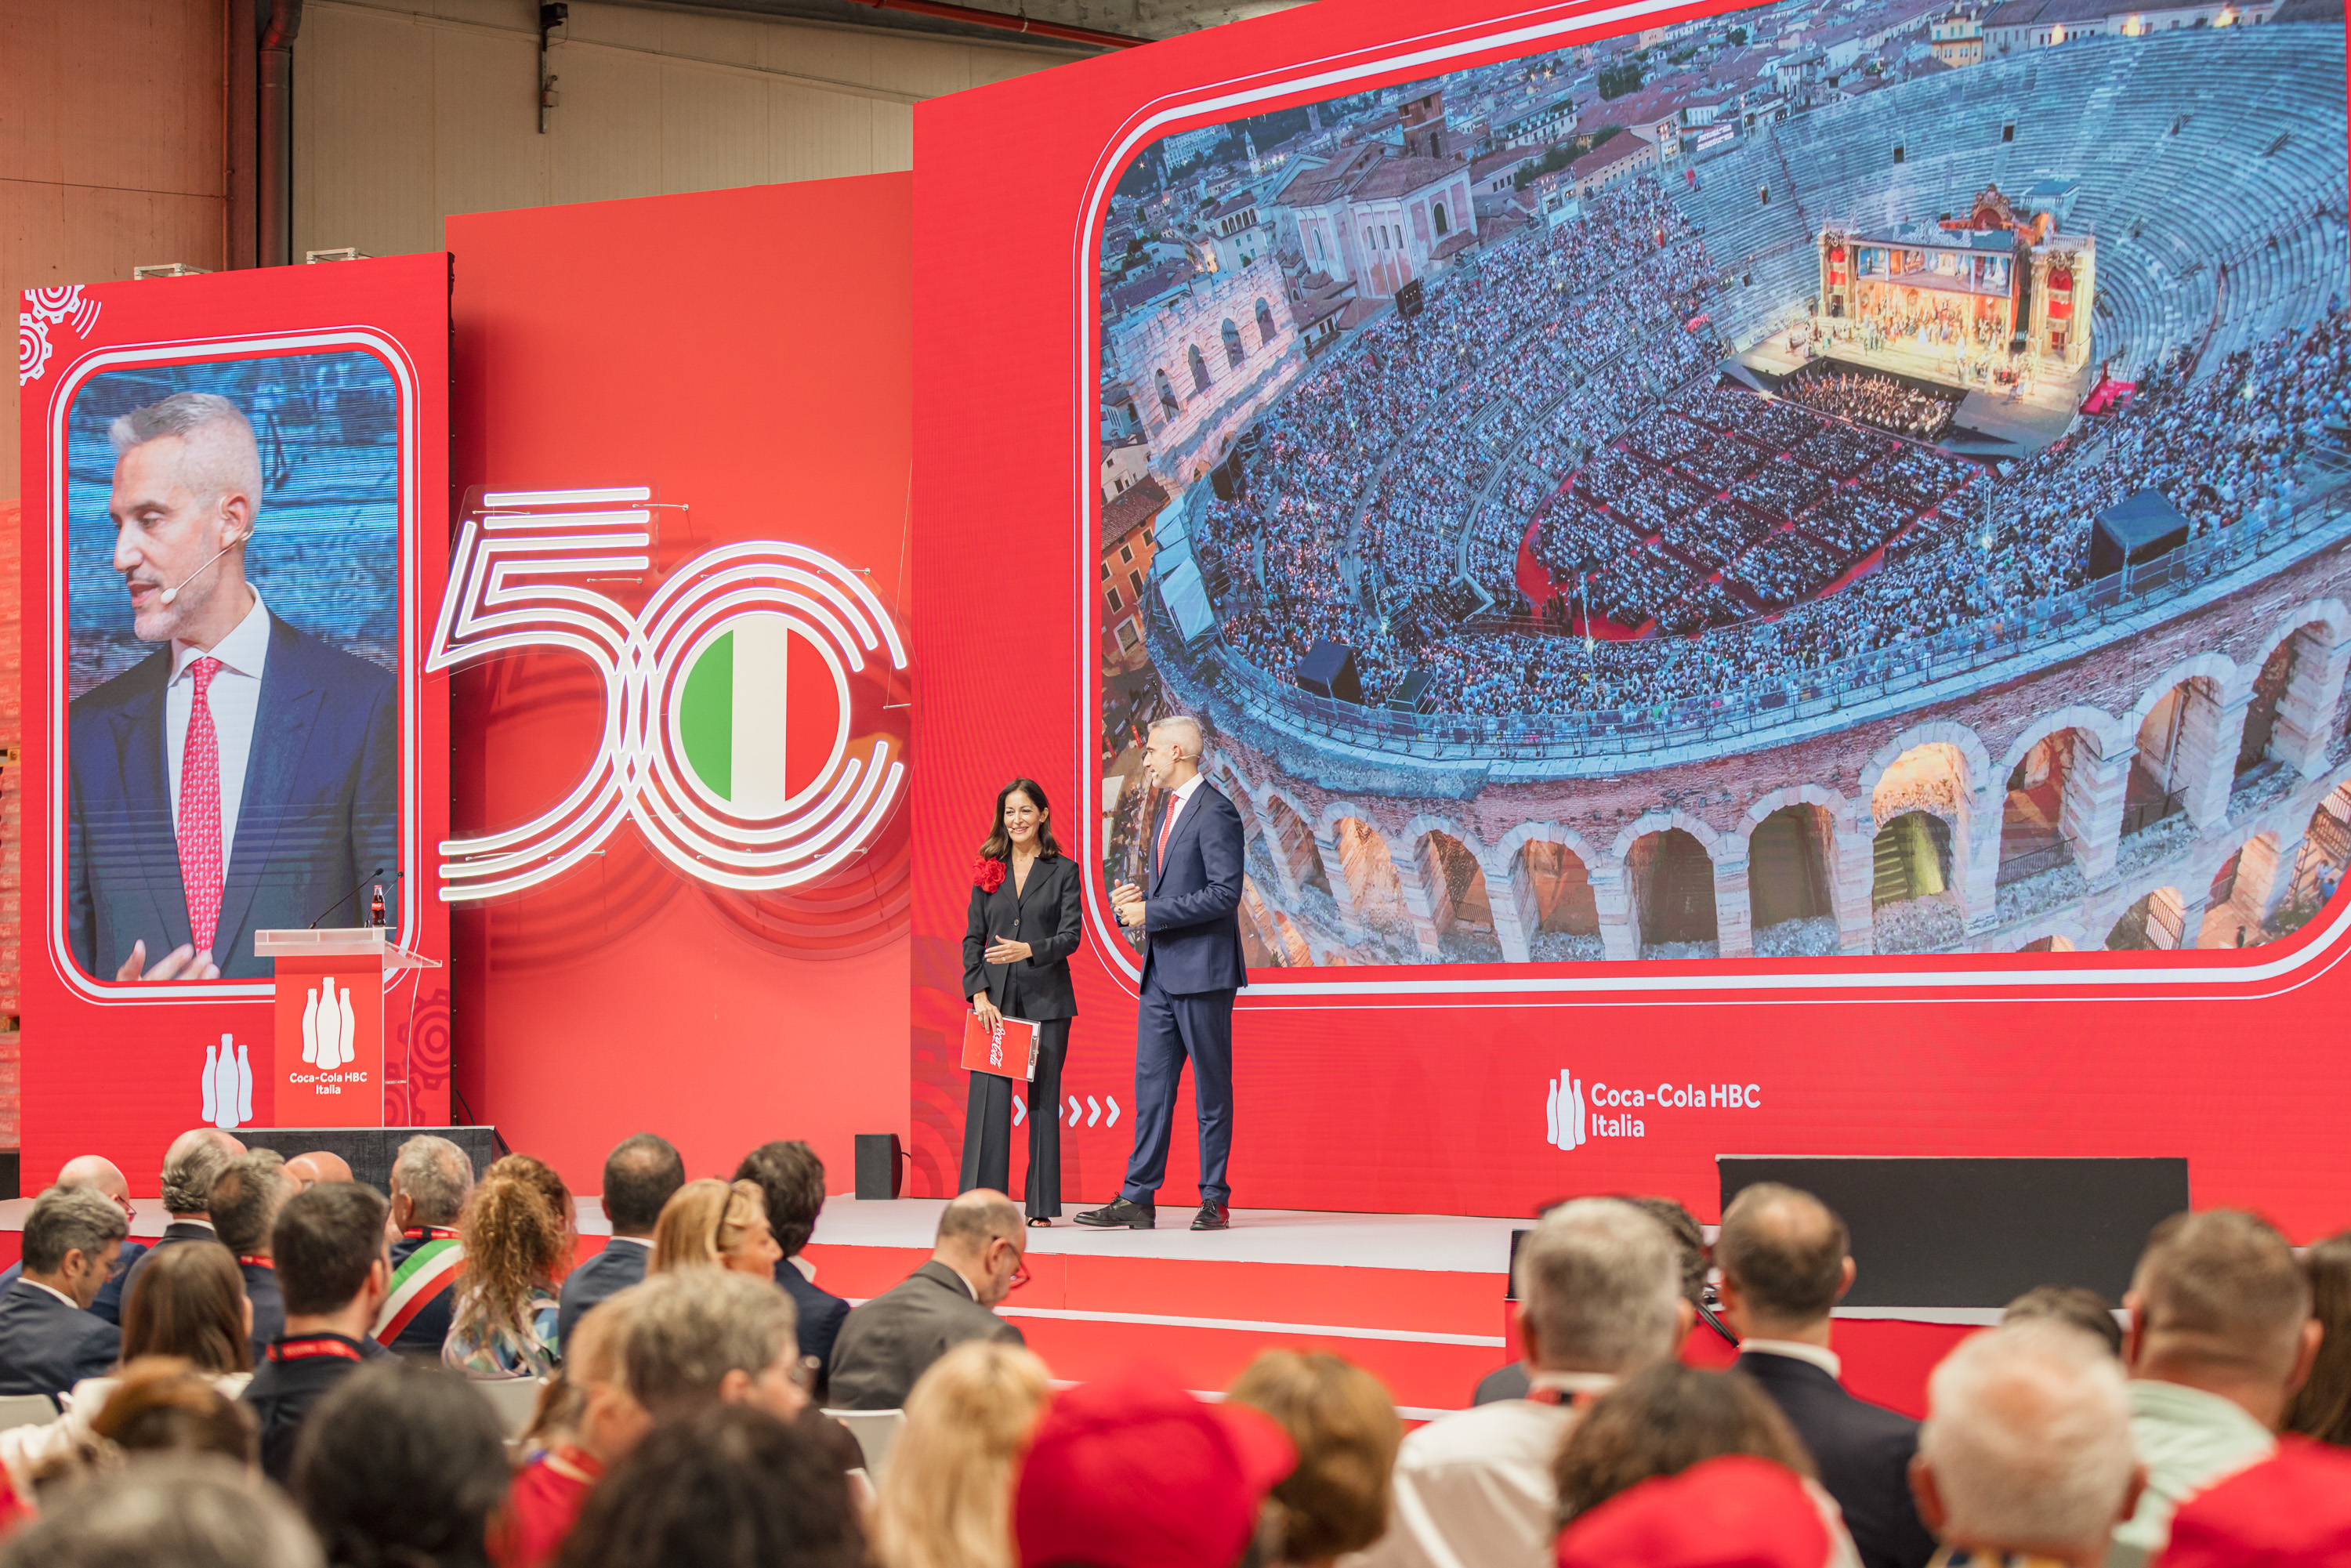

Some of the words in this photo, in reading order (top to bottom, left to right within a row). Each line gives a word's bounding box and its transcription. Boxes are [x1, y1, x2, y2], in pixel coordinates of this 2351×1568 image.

[426, 487, 907, 901] 50
[289, 1072, 342, 1083] Coca-Cola
[345, 1072, 368, 1082] HBC
[316, 1084, 341, 1095] Italia
[1591, 1082, 1706, 1107] Coca-Cola
[1710, 1083, 1761, 1108] HBC
[1592, 1113, 1645, 1137] Italia
